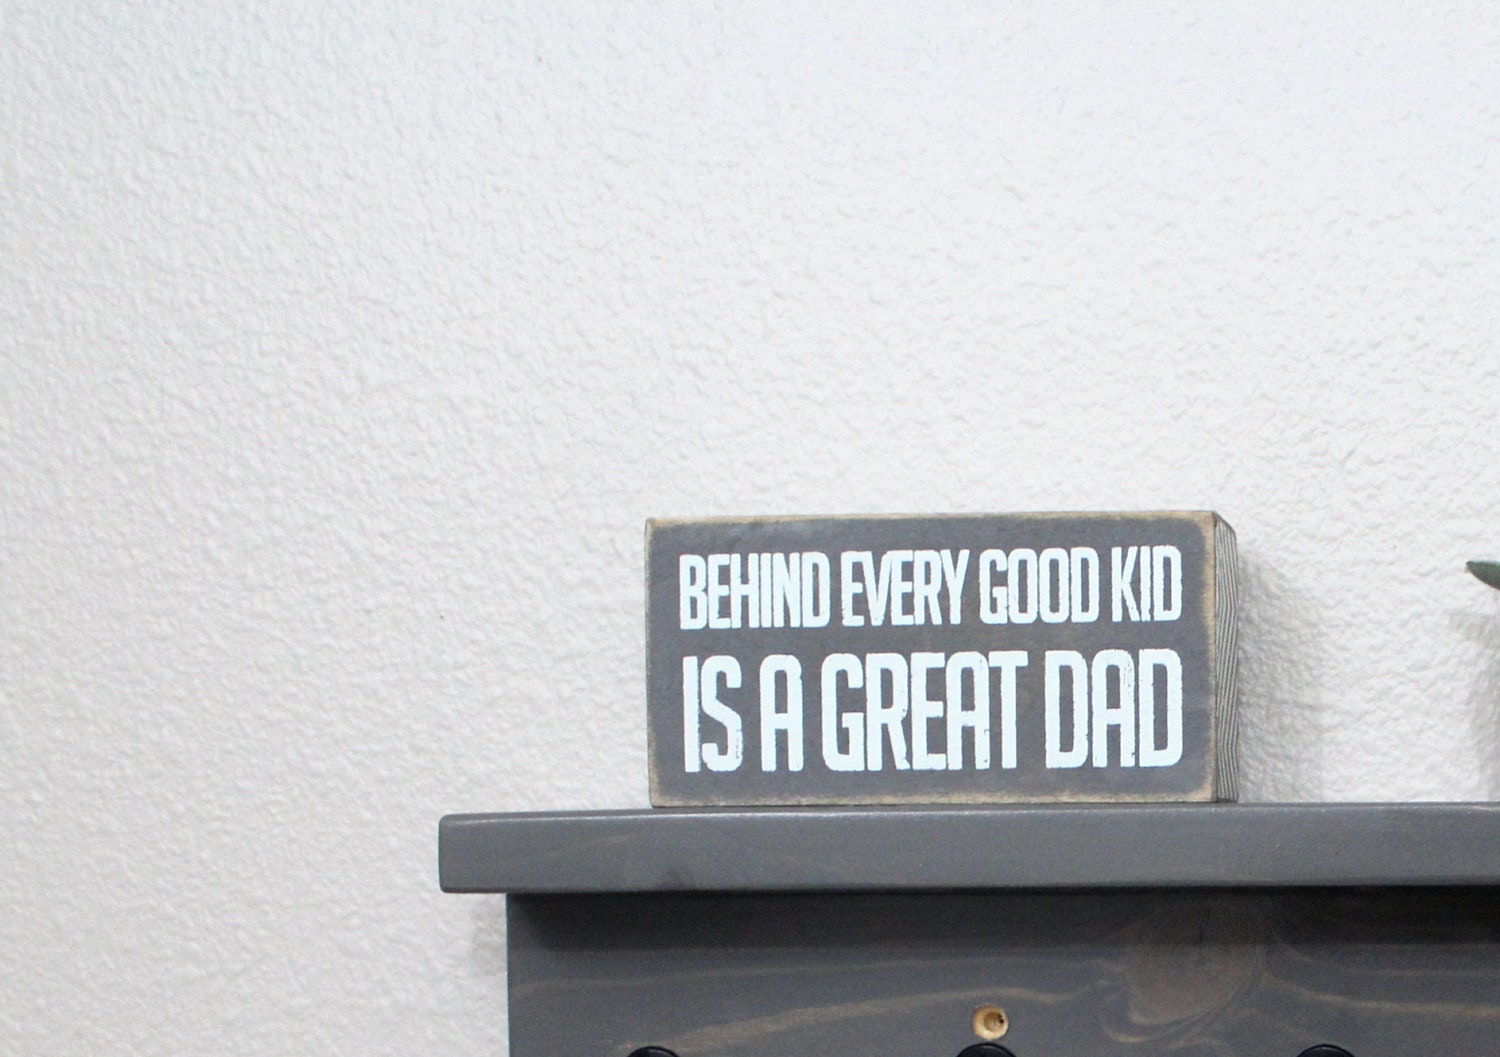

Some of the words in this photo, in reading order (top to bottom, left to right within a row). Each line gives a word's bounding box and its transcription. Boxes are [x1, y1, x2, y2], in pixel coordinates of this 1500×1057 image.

[680, 551, 830, 629] BEHIND
[840, 549, 970, 627] EVERY
[979, 547, 1100, 625] GOOD
[1111, 545, 1182, 622] KID
[682, 655, 743, 772] IS
[759, 654, 804, 772] A
[821, 650, 1028, 772] GREAT
[1044, 648, 1184, 769] DAD
